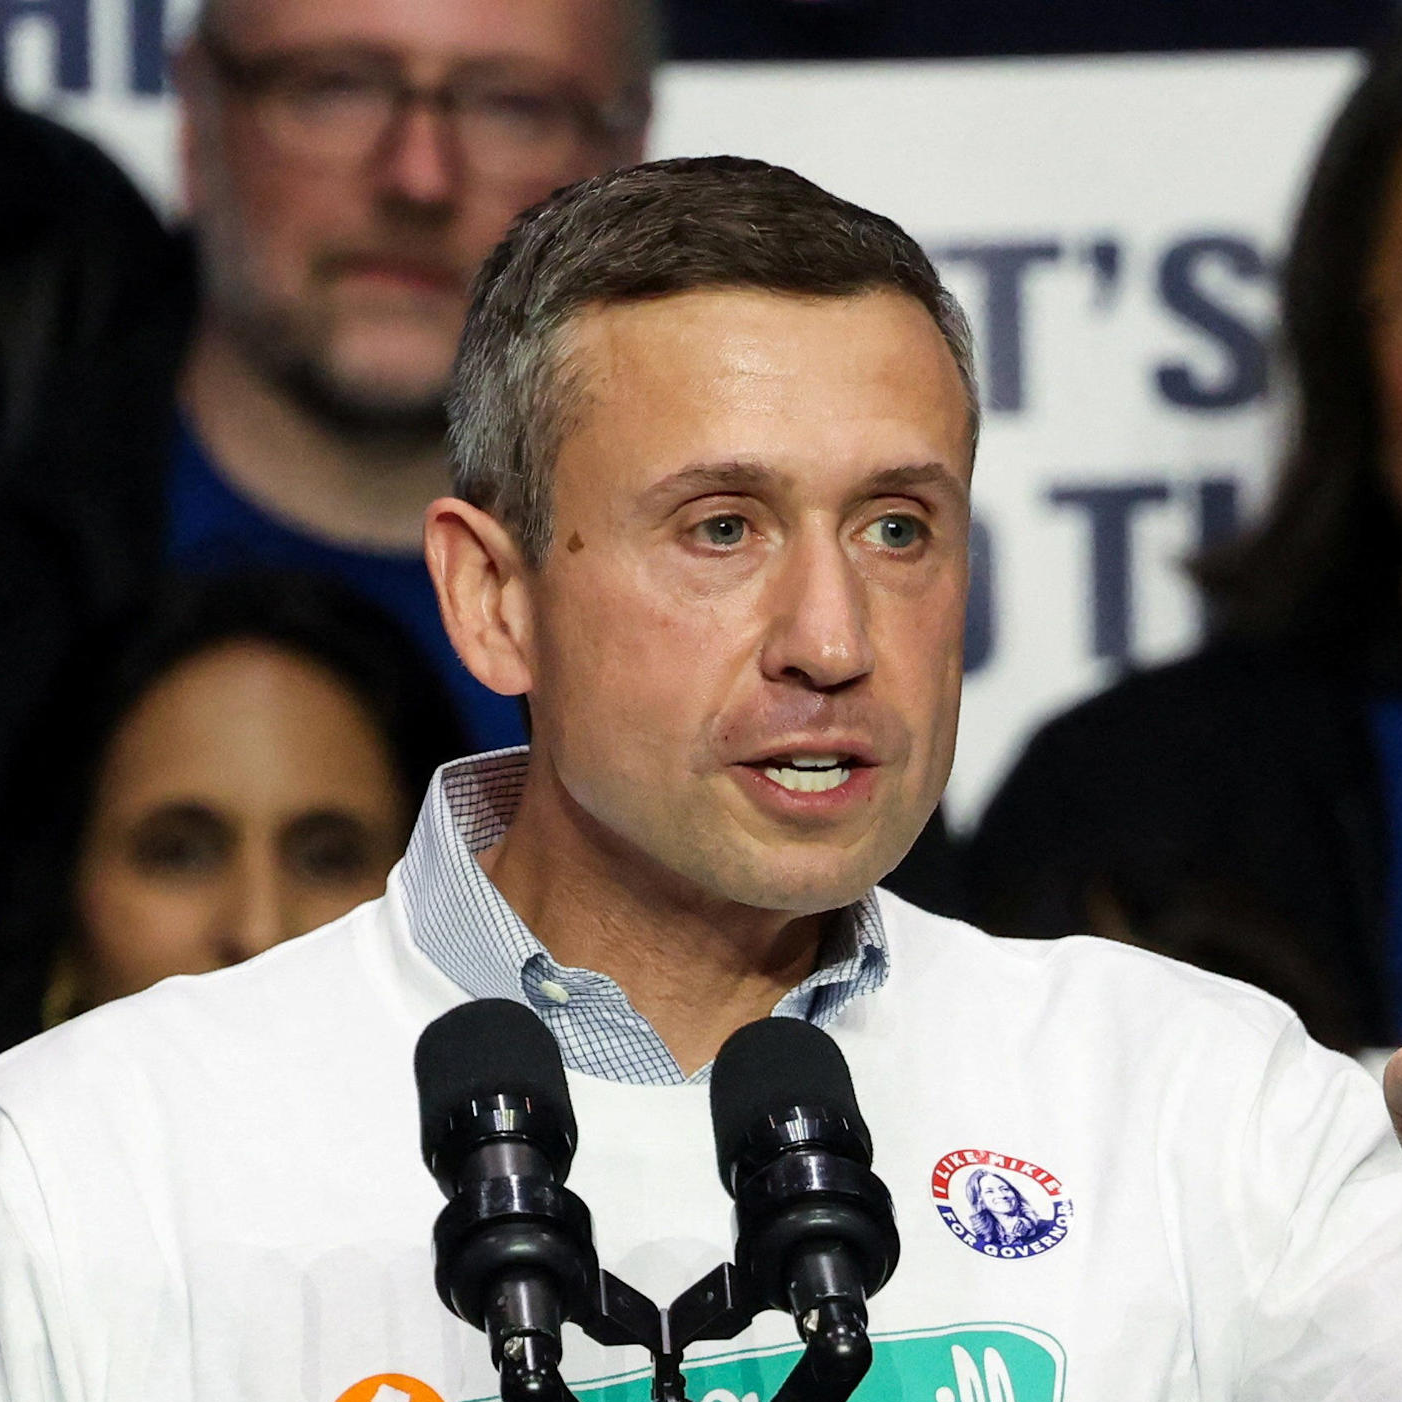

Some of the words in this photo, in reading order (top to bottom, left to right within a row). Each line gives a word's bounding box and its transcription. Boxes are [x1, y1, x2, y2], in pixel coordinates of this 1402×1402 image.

[934, 235, 1272, 413] T'S
[935, 1150, 978, 1180] LIKE
[988, 1153, 1063, 1194] MIKIE
[941, 1211, 977, 1247] FOR
[983, 1199, 1074, 1258] GOVERNOR
